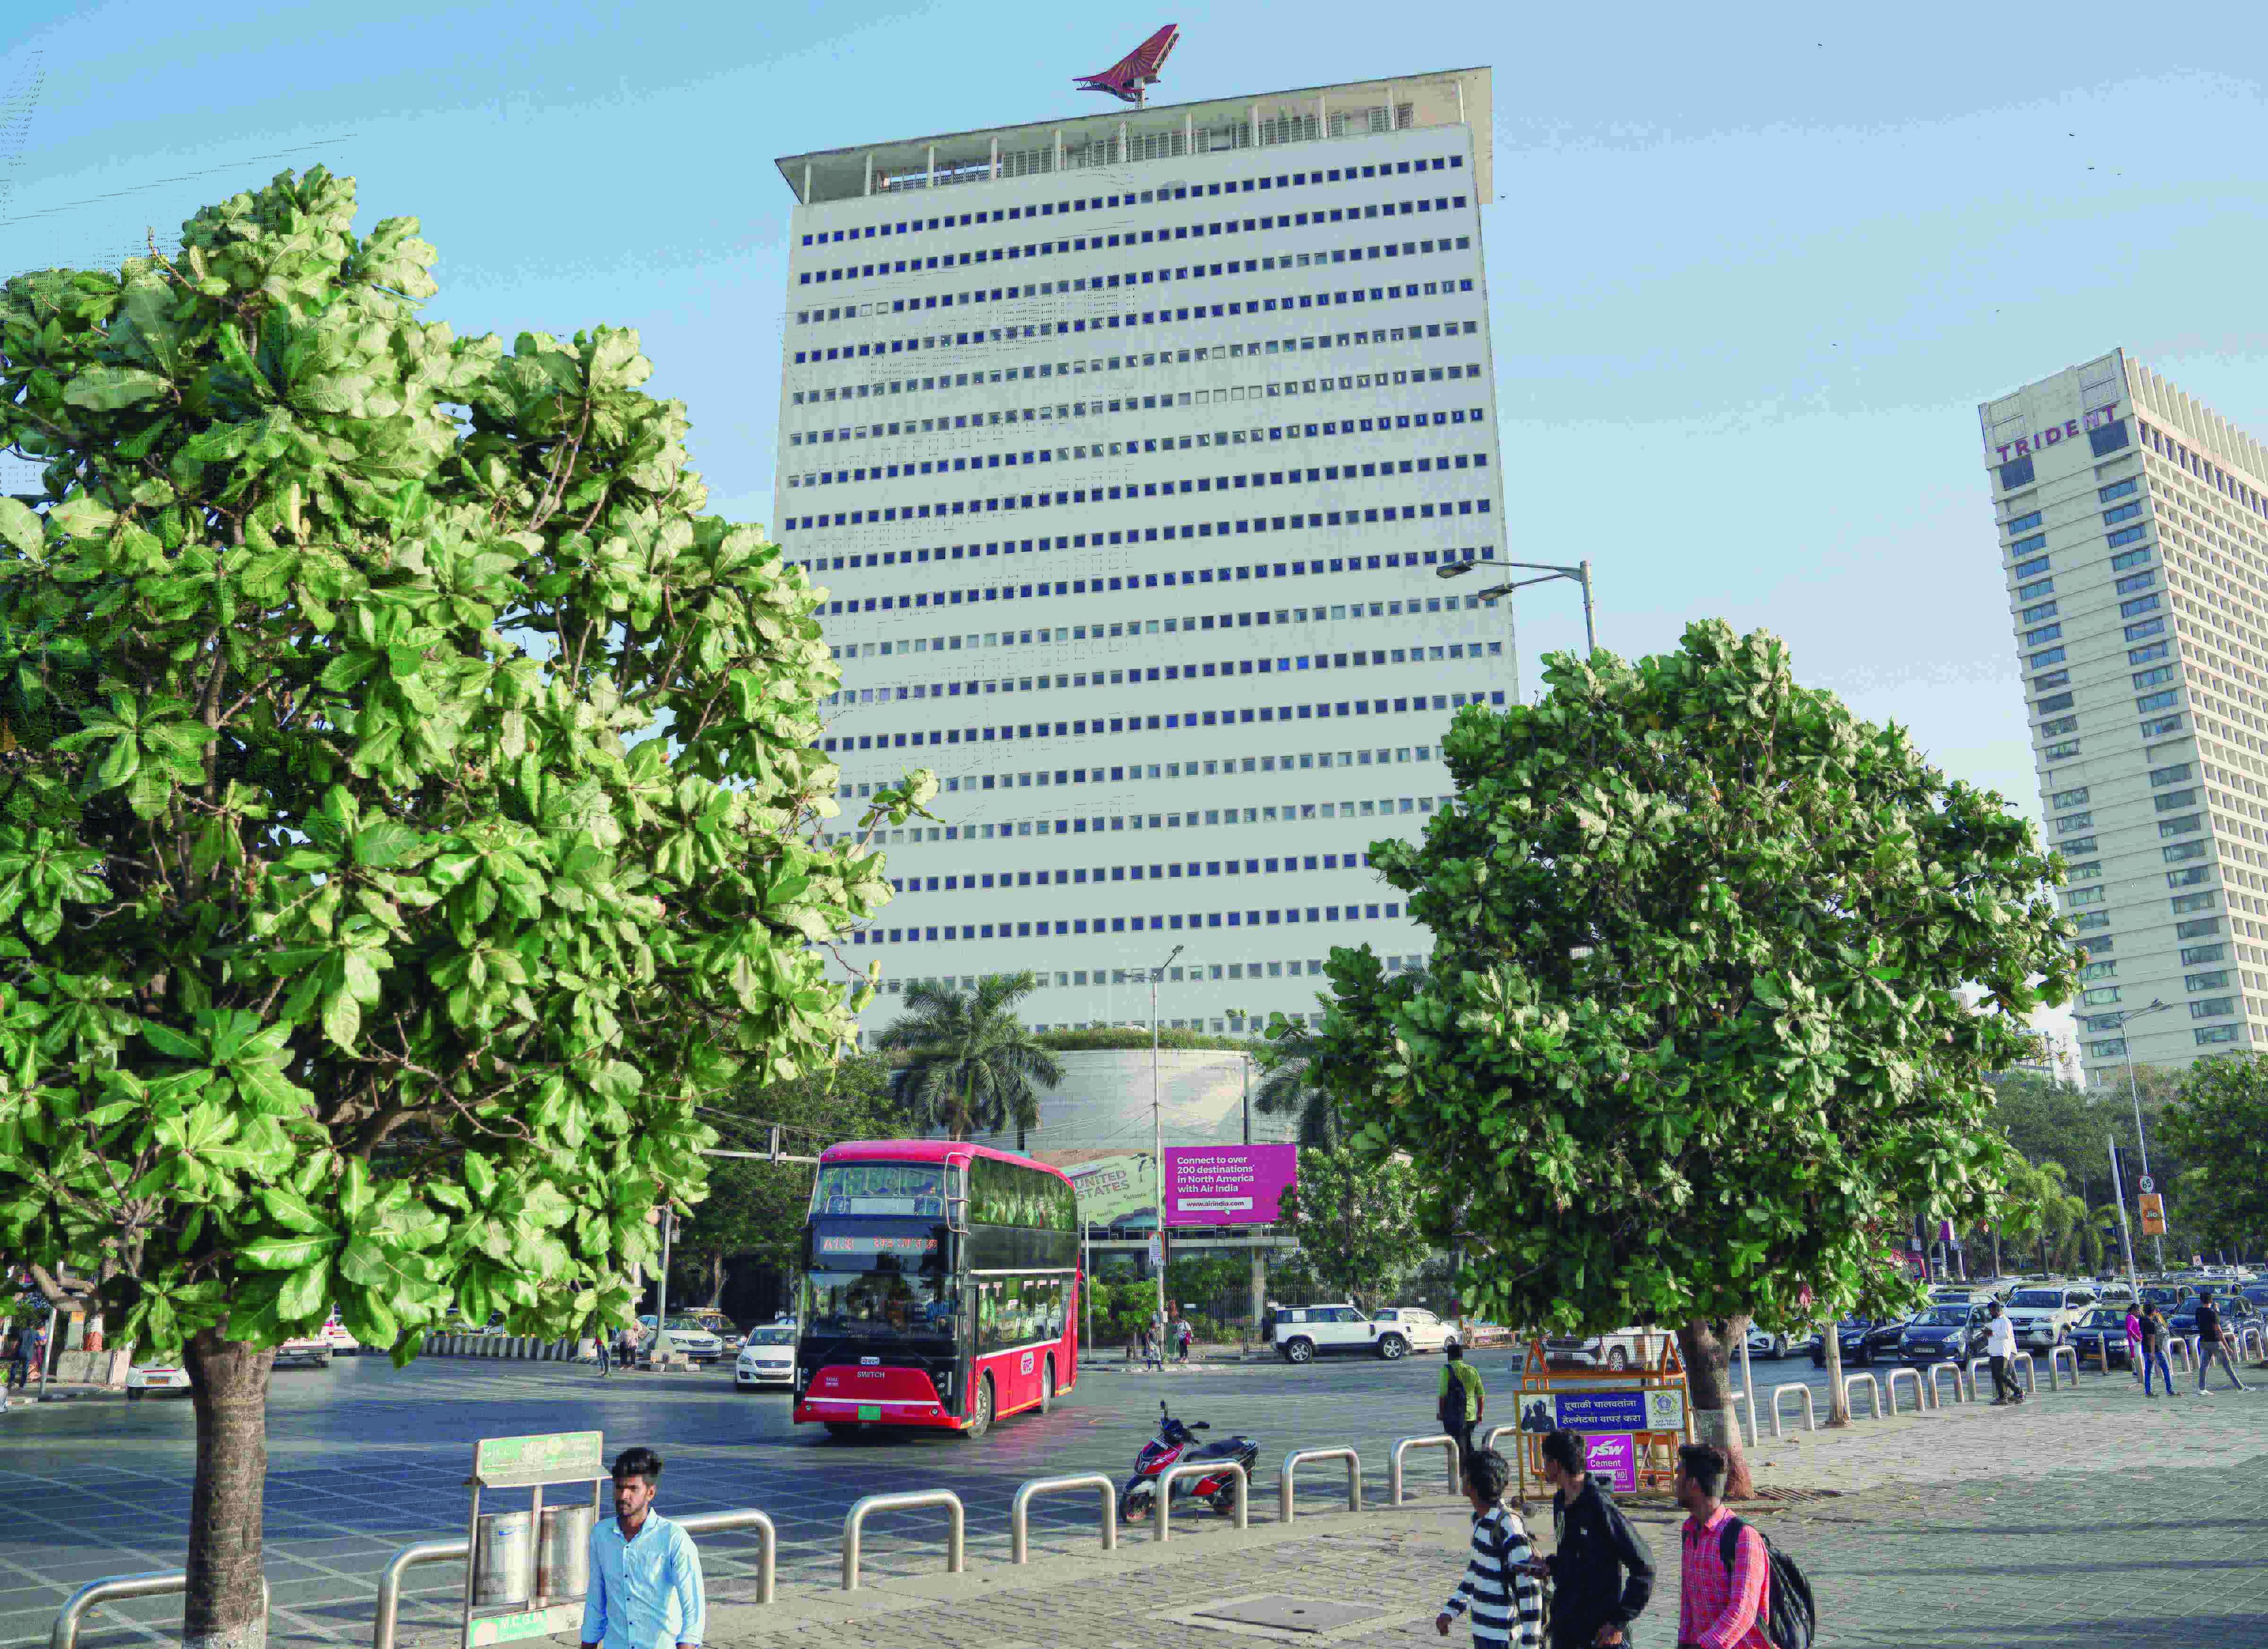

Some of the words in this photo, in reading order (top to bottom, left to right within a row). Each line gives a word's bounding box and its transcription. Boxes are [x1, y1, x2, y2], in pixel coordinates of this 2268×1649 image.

[1996, 404, 2118, 462] TRIDENT
[1177, 1175, 1186, 1183] in
[1188, 1175, 1214, 1183] North
[2142, 1179, 2151, 1188] 65
[1178, 1185, 1198, 1193] with
[2147, 1209, 2157, 1217] Jio
[1587, 1439, 1626, 1459] JSW
